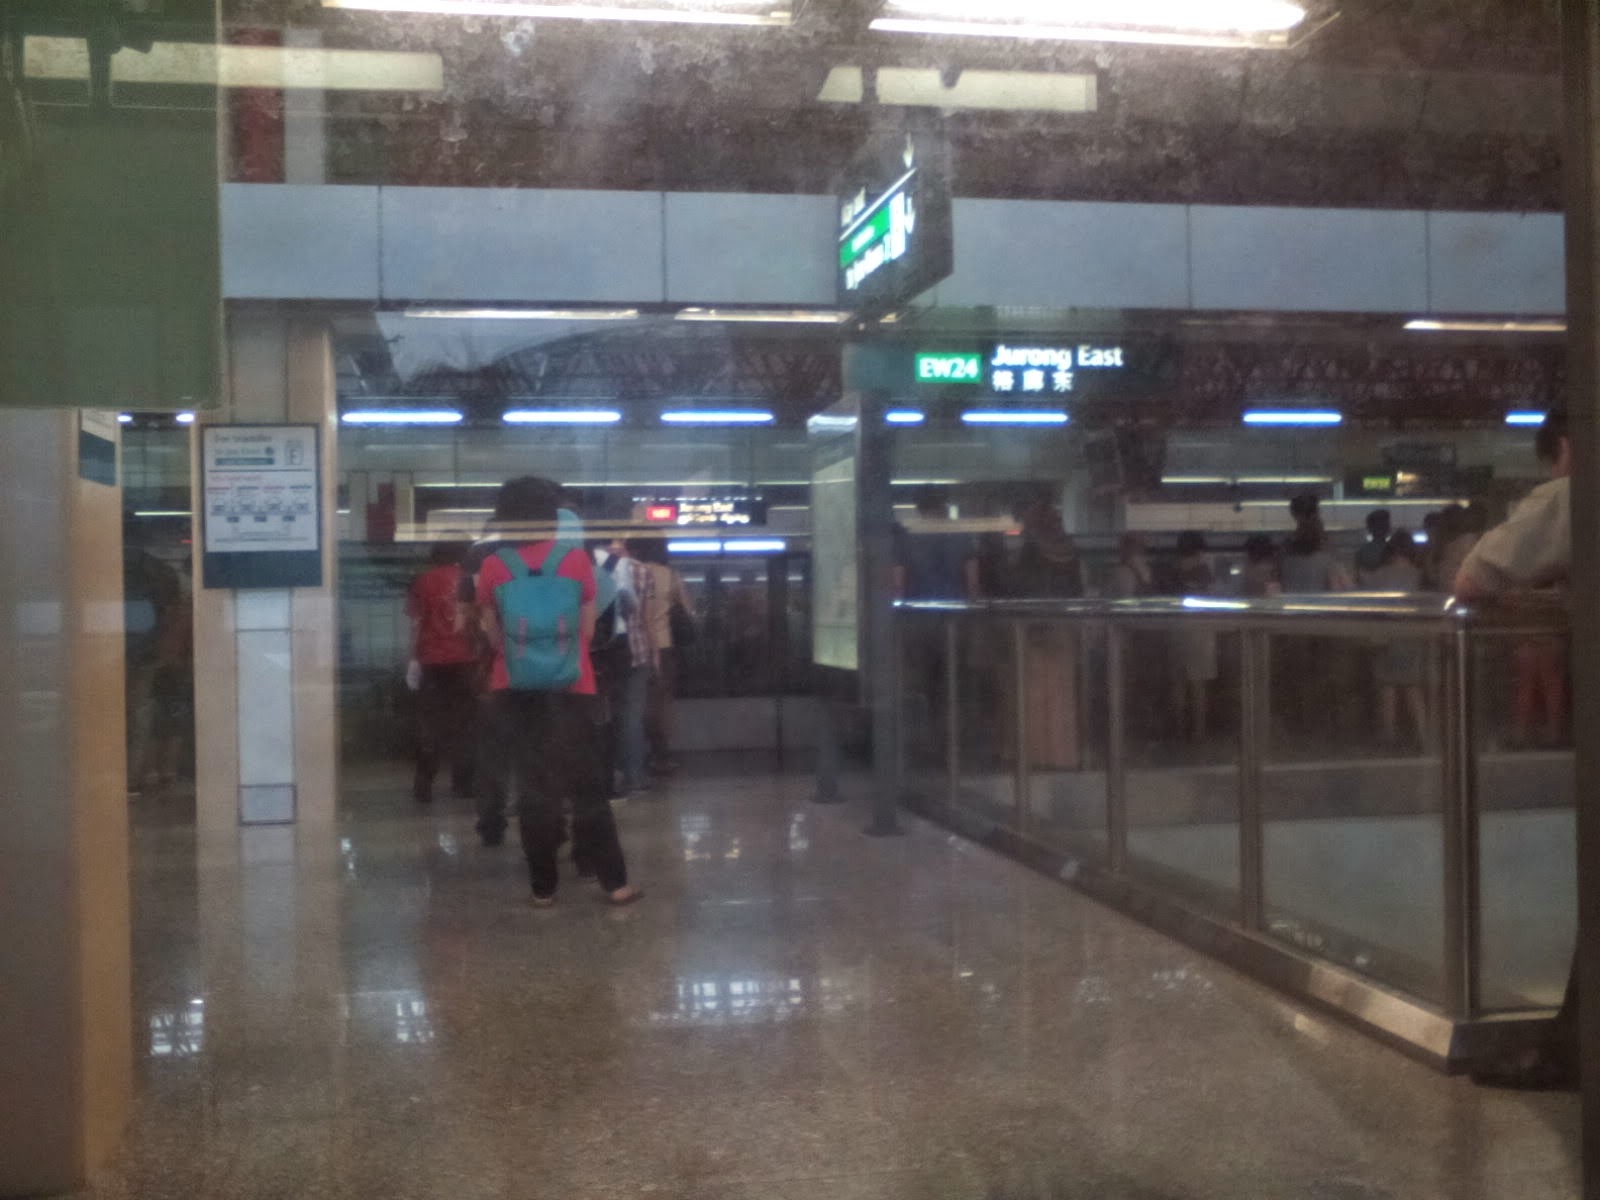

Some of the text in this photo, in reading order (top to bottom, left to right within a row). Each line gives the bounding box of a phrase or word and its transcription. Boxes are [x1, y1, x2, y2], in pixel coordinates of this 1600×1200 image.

[919, 357, 979, 379] EW24
[991, 345, 1124, 370] Jurong East
